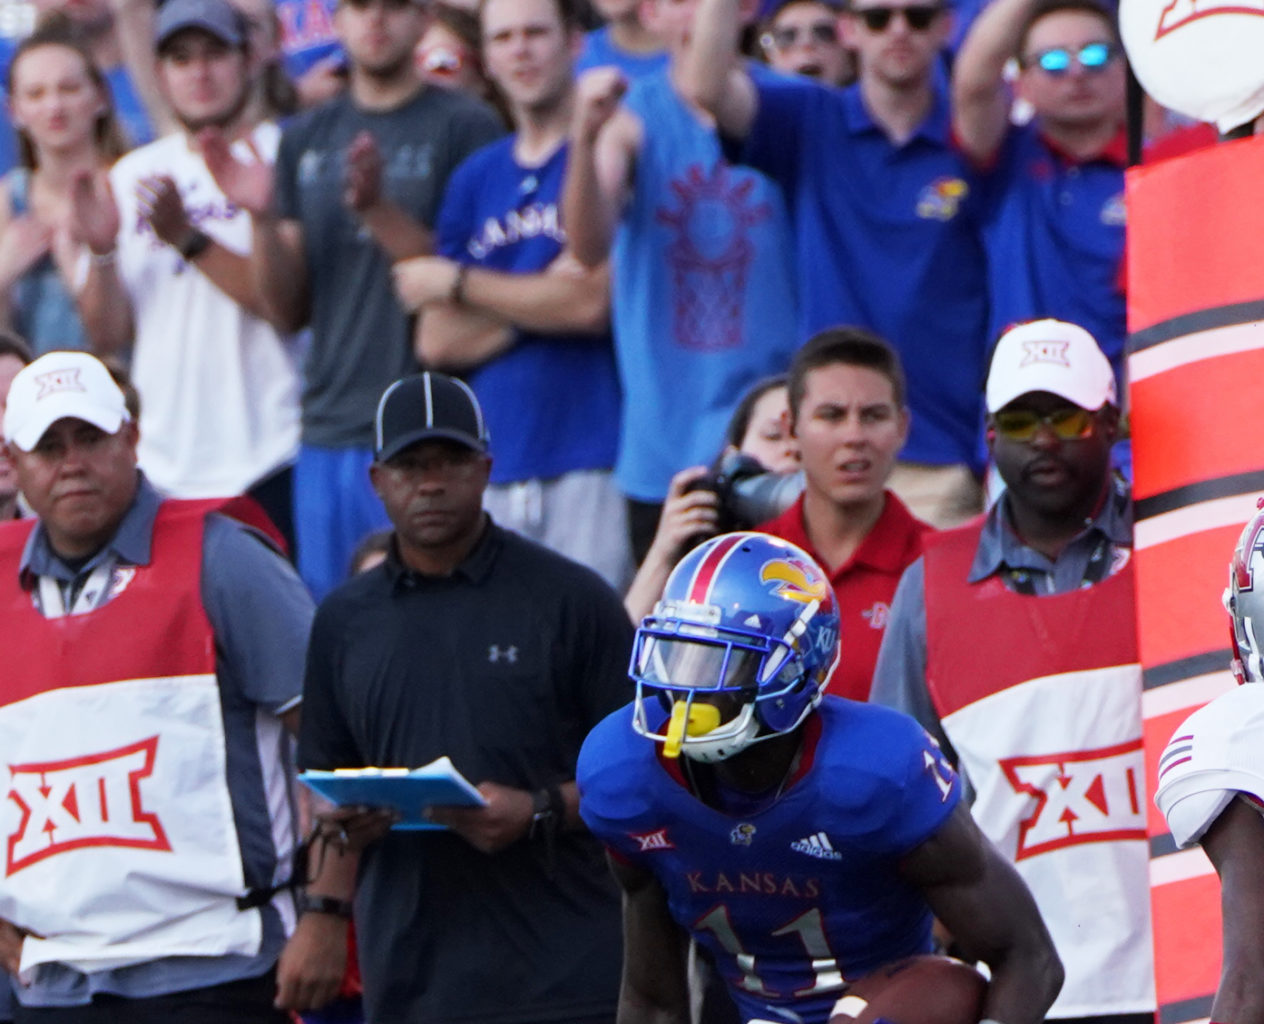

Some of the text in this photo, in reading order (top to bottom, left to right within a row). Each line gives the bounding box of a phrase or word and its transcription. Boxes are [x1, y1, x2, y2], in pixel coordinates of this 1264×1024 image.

[628, 829, 676, 851] XII
[790, 841, 843, 861] adidas
[686, 872, 820, 898] KANSAS
[692, 903, 849, 999] 11
